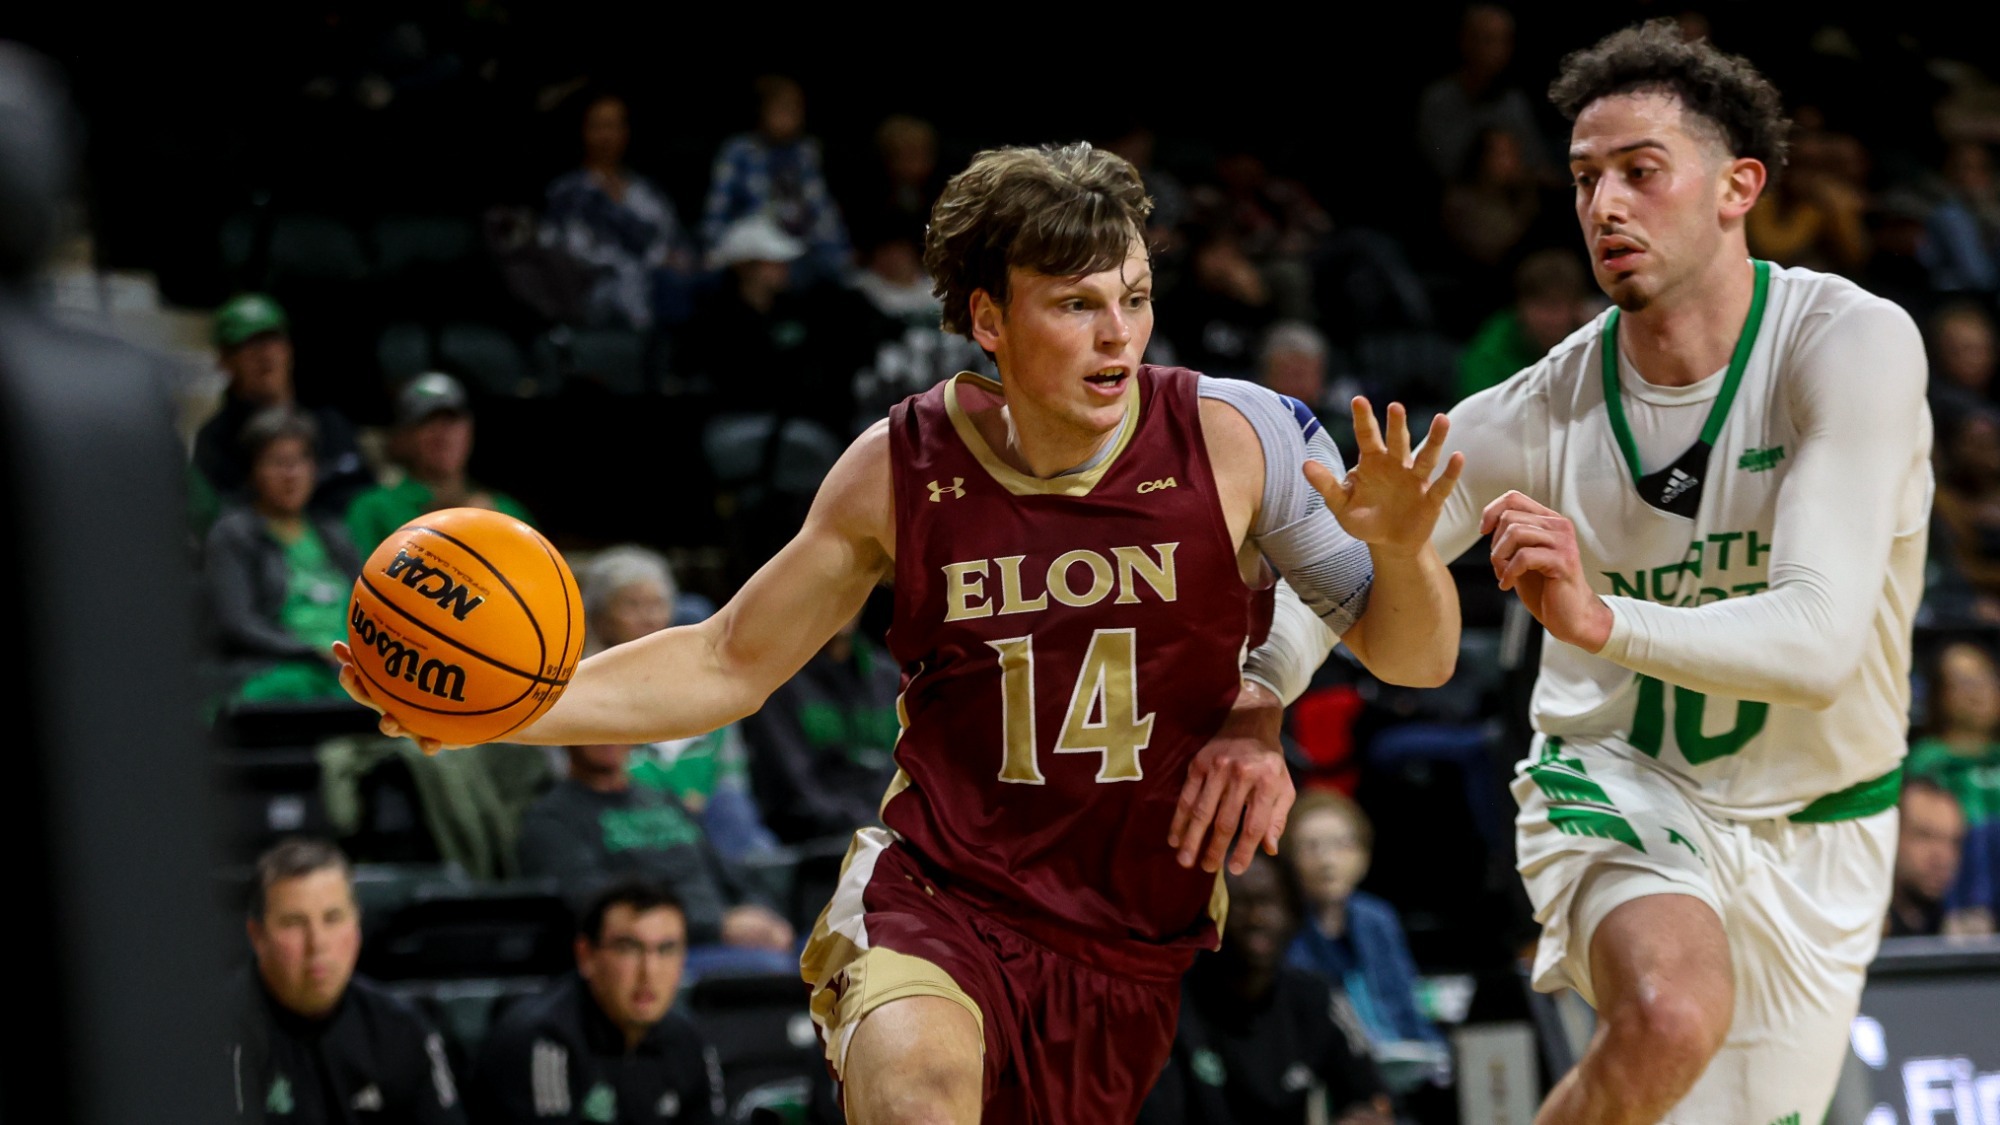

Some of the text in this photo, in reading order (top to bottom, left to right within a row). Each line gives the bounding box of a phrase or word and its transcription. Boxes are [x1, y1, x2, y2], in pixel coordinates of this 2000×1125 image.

[1136, 476, 1178, 494] CAA
[385, 546, 485, 622] NCAA
[941, 541, 1181, 623] ELON
[351, 597, 466, 702] Wilson
[983, 627, 1156, 786] 14
[1629, 671, 1770, 766] 10
